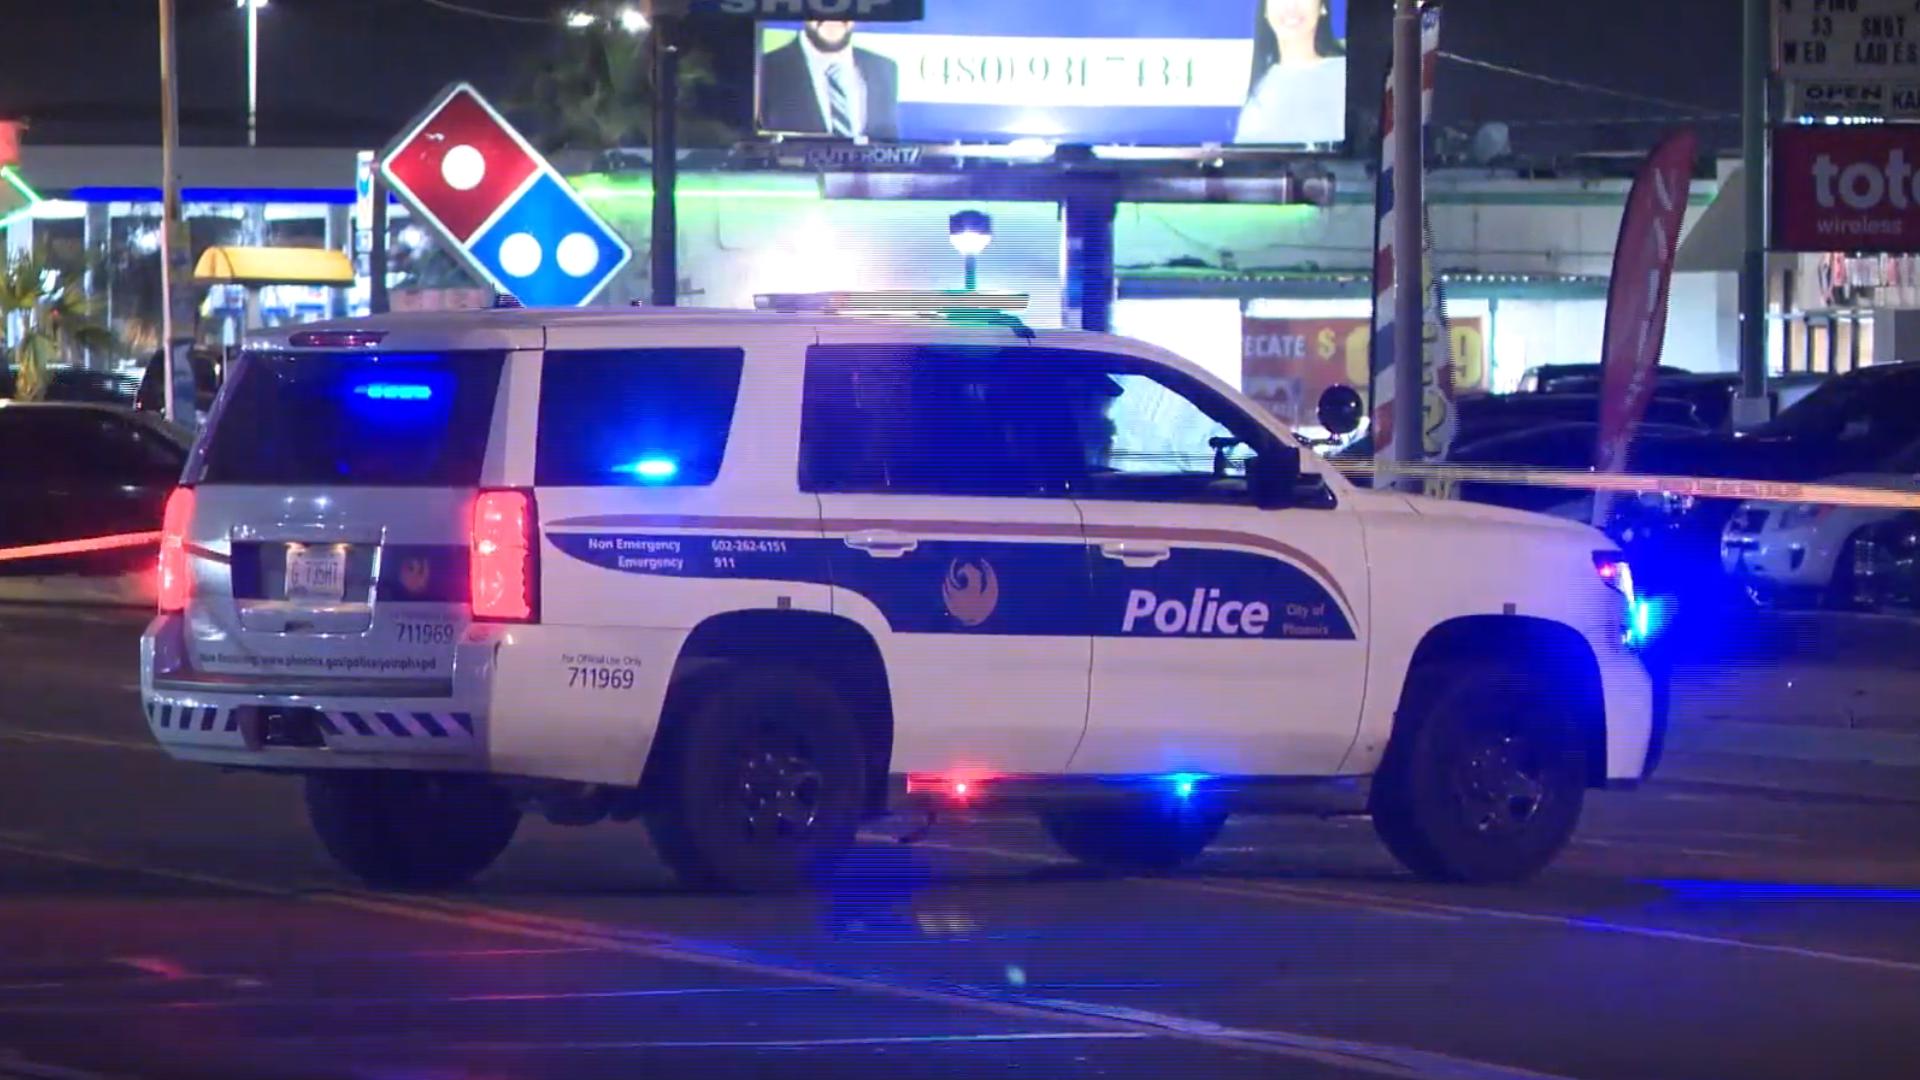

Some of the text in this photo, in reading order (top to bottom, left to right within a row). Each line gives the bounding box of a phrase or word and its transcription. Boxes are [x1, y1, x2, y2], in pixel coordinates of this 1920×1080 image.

[1783, 42, 1826, 63] WED
[1806, 84, 1882, 99] OPEN
[1812, 149, 1920, 210] tot
[1816, 215, 1903, 234] wireless
[588, 538, 614, 550] Non
[616, 539, 681, 552] Emergency
[617, 555, 736, 570] Emergency 911
[1121, 587, 1270, 634] Police
[1286, 603, 1325, 618] City of
[396, 622, 455, 645] 711969
[623, 656, 642, 667] Only
[567, 667, 634, 690] 711969
